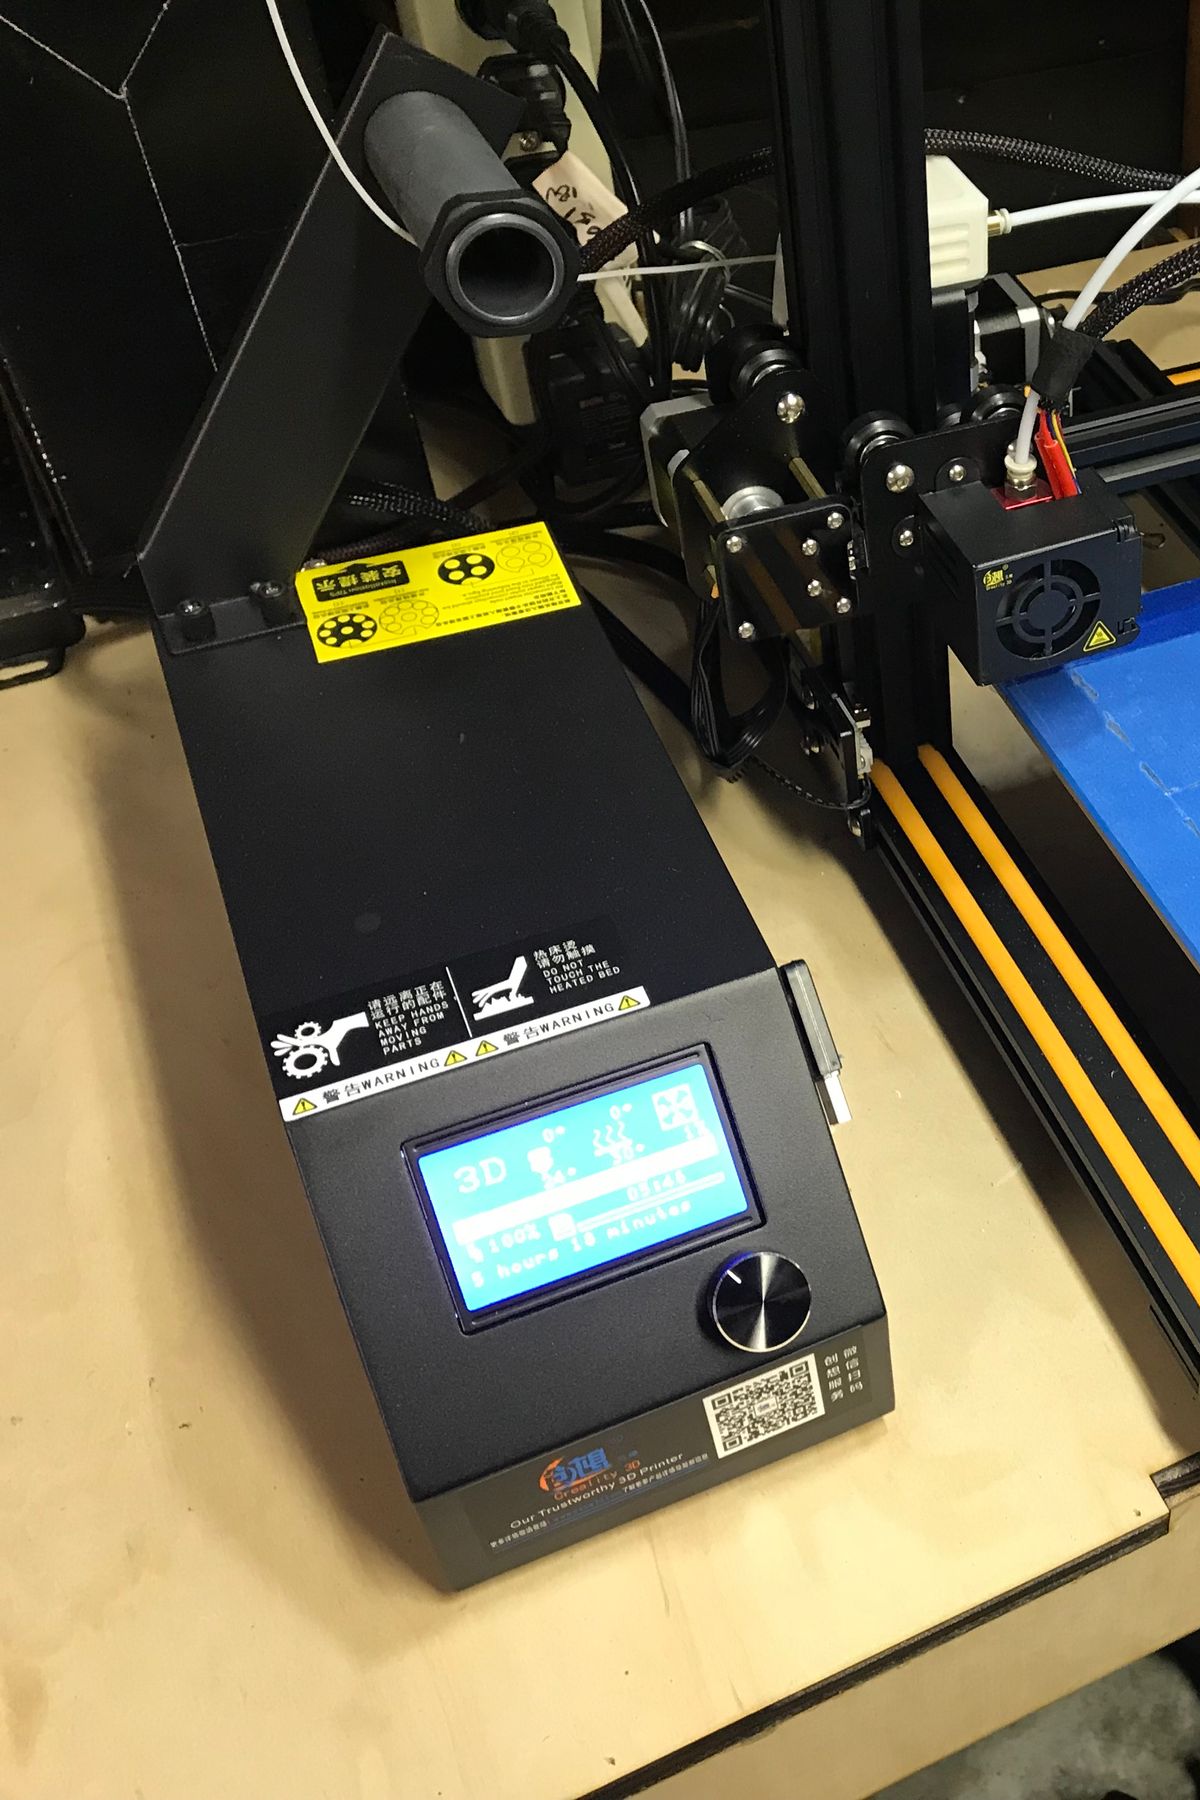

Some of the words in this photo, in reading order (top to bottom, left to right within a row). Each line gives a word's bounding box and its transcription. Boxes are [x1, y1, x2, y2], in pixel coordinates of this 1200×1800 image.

[543, 967, 558, 978] DO
[562, 959, 583, 972] NOT
[546, 969, 583, 985] TOUCH
[588, 960, 610, 972] THE
[549, 975, 593, 994] HEATED
[598, 966, 620, 979] BED
[375, 1014, 405, 1030] KEEP
[411, 1001, 448, 1019] HANDS
[379, 1022, 407, 1038] AWAY
[414, 1011, 444, 1027] FROM
[380, 1026, 427, 1046] MOVING
[383, 1037, 421, 1055] PARTS
[453, 1157, 508, 1194] 3D
[497, 1247, 559, 1279] hours
[607, 1200, 691, 1240] minutes
[510, 1515, 537, 1529] Our
[538, 1482, 616, 1517] Trustworthy
[618, 1472, 636, 1485] 3D
[640, 1453, 684, 1475] Printer
